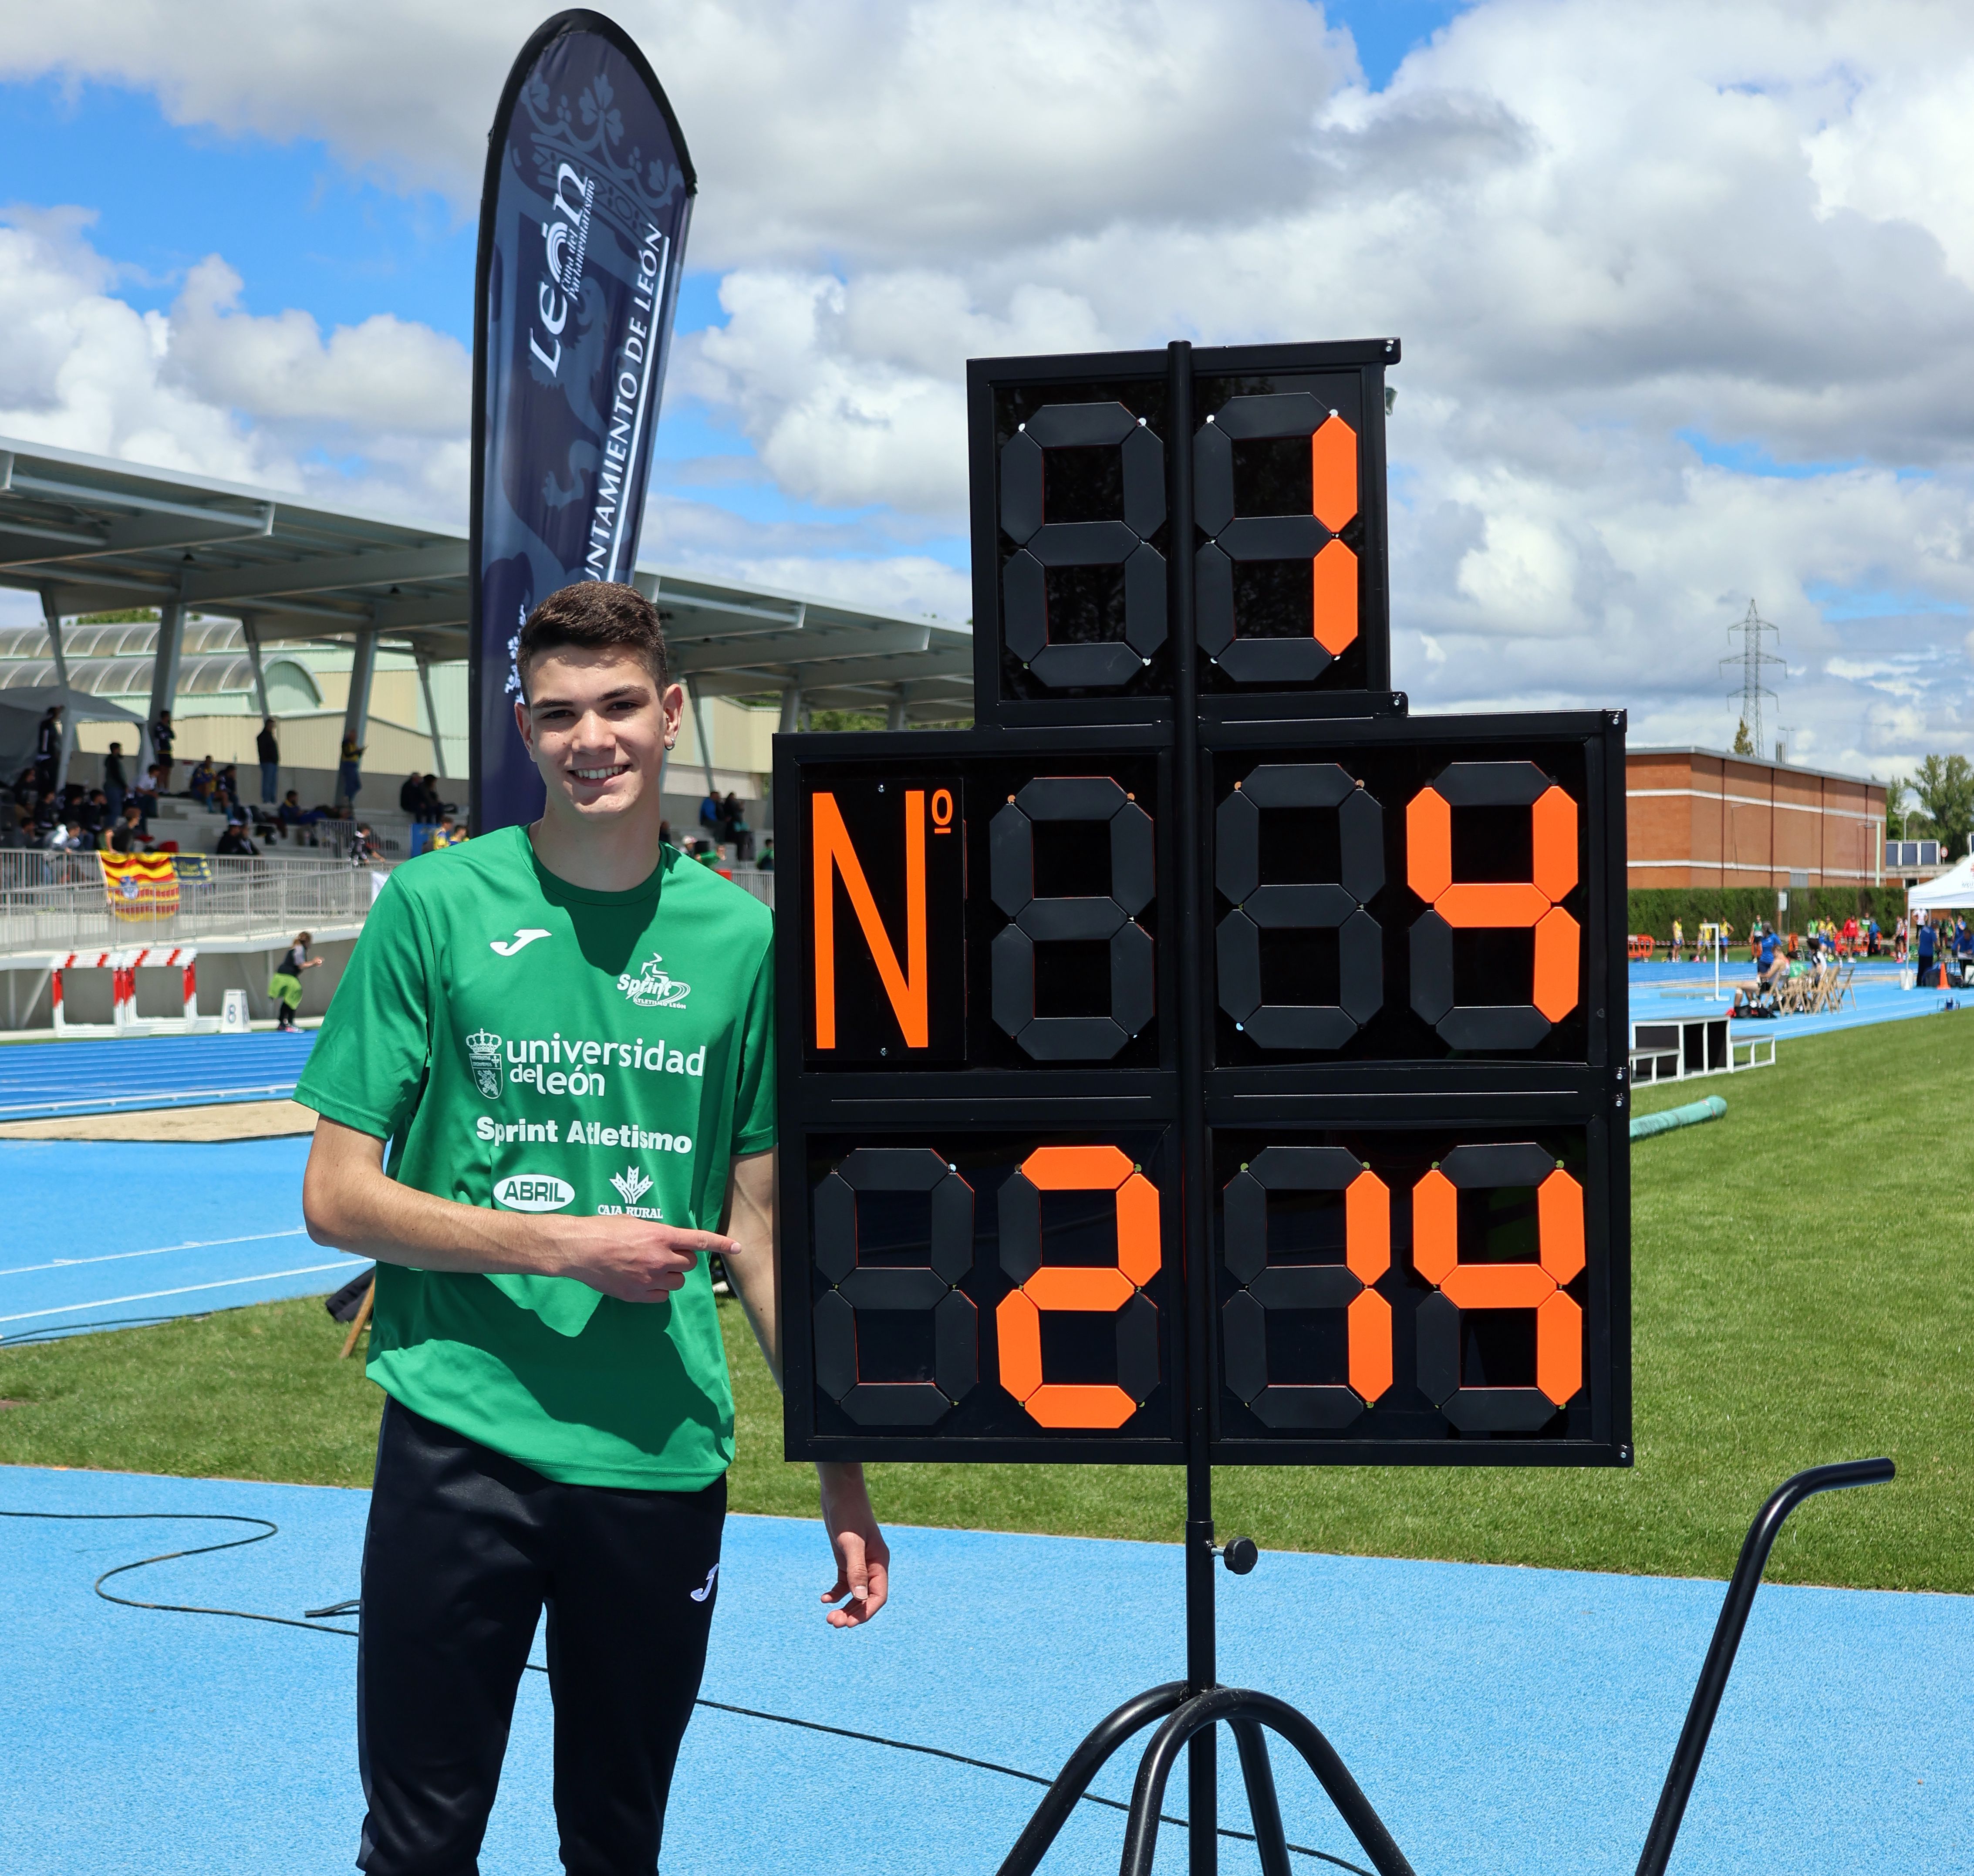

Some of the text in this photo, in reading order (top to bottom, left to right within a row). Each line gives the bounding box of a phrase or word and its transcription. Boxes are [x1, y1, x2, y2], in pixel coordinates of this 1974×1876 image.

[560, 228, 578, 293] Cuna del
[567, 179, 595, 301] Parlamentarismo
[634, 223, 662, 313] LEÓN
[624, 317, 648, 364] DE
[1313, 416, 1357, 655] 1
[1407, 786, 1580, 1022] 4
[617, 973, 672, 996] Sprint
[633, 997, 668, 1007] ATLETISMO
[506, 1032, 706, 1076] universidad
[510, 1064, 606, 1097] de león
[476, 1116, 693, 1154] Sprint Atletismo
[503, 1181, 566, 1203] ABRIL
[597, 1205, 664, 1219] CAJA RURAL
